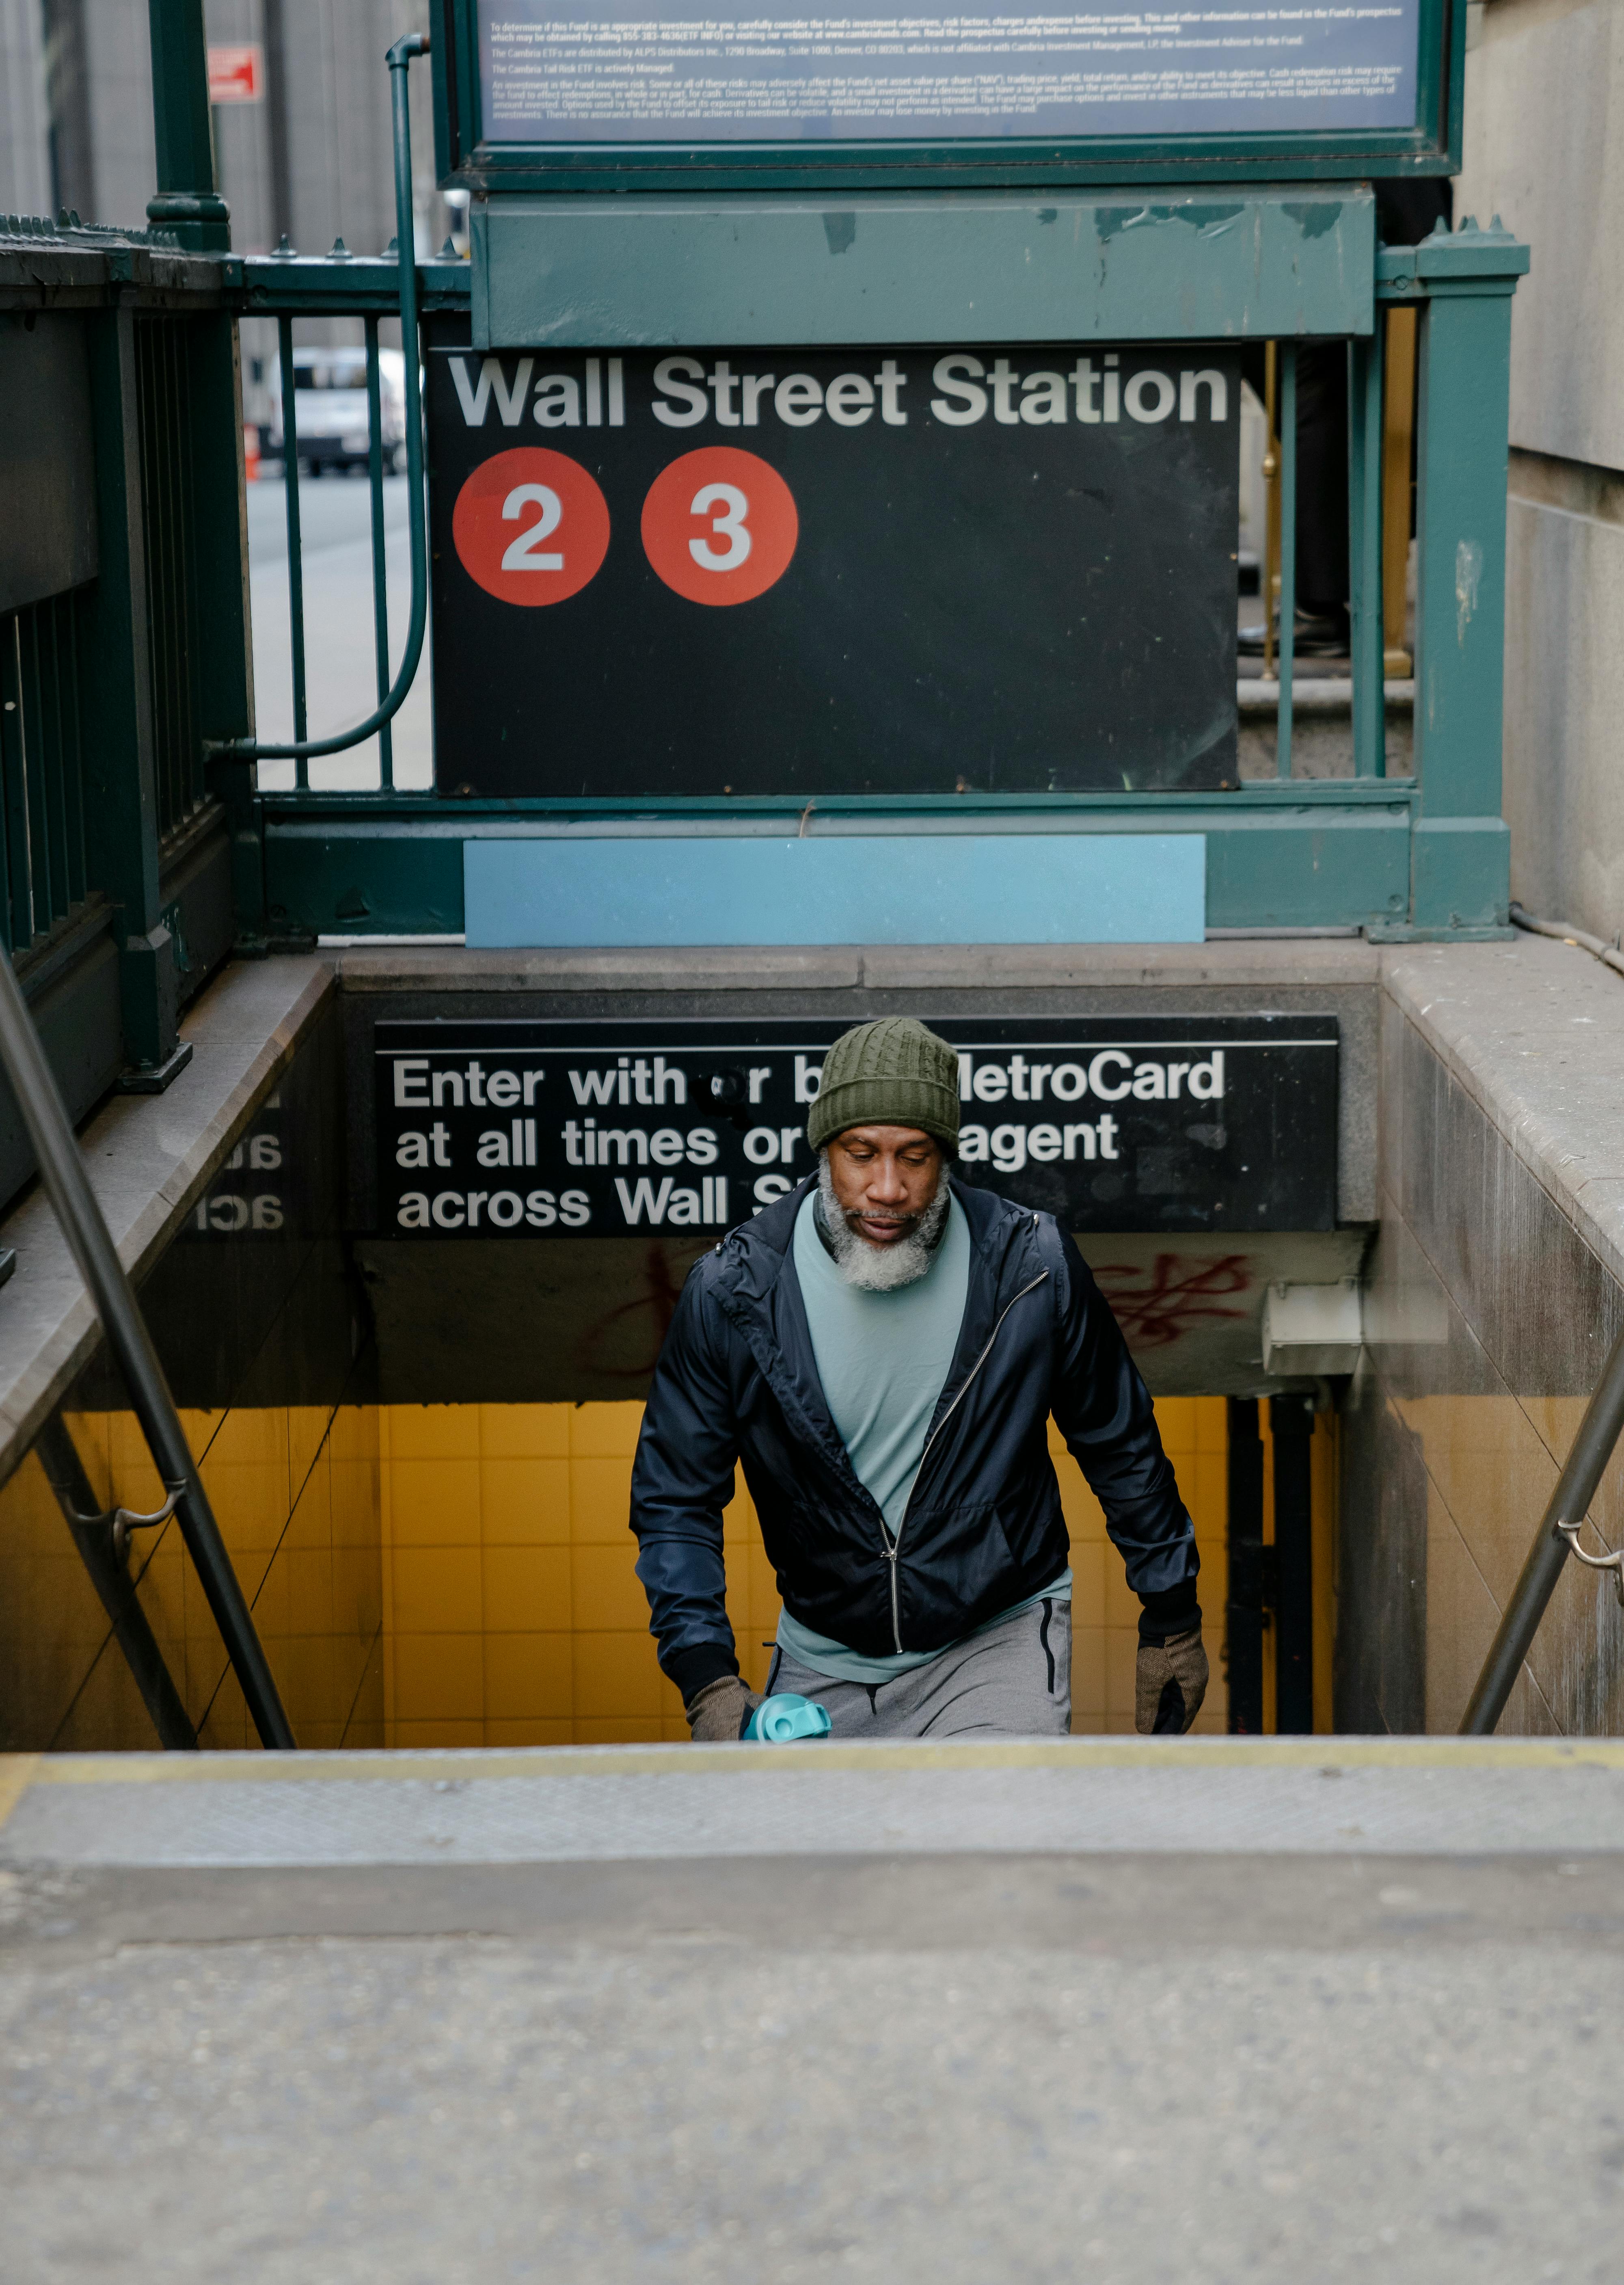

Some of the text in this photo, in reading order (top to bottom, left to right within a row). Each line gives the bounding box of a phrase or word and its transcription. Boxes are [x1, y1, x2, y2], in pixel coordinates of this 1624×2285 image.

[490, 22, 500, 31] To
[501, 22, 542, 31] determine
[543, 22, 550, 31] if
[551, 22, 566, 30] this
[568, 22, 589, 30] Fund
[590, 22, 597, 30] is
[611, 21, 657, 32] appropriate
[658, 20, 703, 30] investment
[704, 20, 716, 29] for
[737, 19, 772, 31] carefully
[773, 19, 807, 28] consider
[809, 19, 823, 28] the
[851, 18, 896, 28] investment
[943, 17, 958, 26] risk
[992, 16, 1024, 28] charges
[1074, 14, 1100, 24] before
[1144, 13, 1160, 22] This
[1162, 13, 1178, 22] and
[1179, 12, 1200, 22] other
[1202, 11, 1249, 21] information
[1267, 10, 1277, 19] be
[1280, 9, 1302, 19] found
[1304, 9, 1312, 18] in
[1313, 9, 1327, 18] the
[1356, 7, 1401, 19] prospectus
[490, 32, 514, 41] which
[515, 34, 532, 43] may
[534, 32, 544, 41] be
[546, 32, 581, 41] obtained
[582, 32, 592, 43] by
[594, 31, 620, 43] calling
[736, 30, 764, 41] visiting
[782, 29, 812, 39] website
[814, 30, 823, 38] at
[923, 27, 944, 37] Read
[945, 27, 958, 36] the
[960, 27, 1004, 39] prospectus
[1006, 26, 1041, 38] carefully
[1043, 25, 1069, 35] before
[1070, 24, 1107, 36] investing
[1119, 23, 1151, 35] sending
[491, 49, 505, 58] The
[507, 48, 540, 58] Cambria
[542, 48, 561, 57] ETFs
[578, 48, 621, 57] distributed
[622, 48, 632, 59] by
[634, 48, 655, 57] ALPS
[657, 47, 704, 56] Distributors
[725, 47, 744, 56] 1290
[789, 46, 808, 55] Suite
[864, 45, 876, 54] CO
[907, 44, 930, 54] which
[931, 44, 939, 53] is
[940, 45, 954, 53] not
[956, 43, 991, 53] affiliated
[992, 43, 1009, 52] with
[1011, 42, 1045, 52] Cambria
[1045, 41, 1090, 51] Investment
[1160, 39, 1173, 49] the
[1175, 38, 1220, 48] Investment
[1221, 37, 1251, 47] Adviser
[1253, 37, 1264, 46] for
[1266, 37, 1279, 46] the
[492, 64, 506, 73] The
[508, 63, 541, 72] Cambria
[544, 63, 557, 72] Tail
[558, 63, 575, 72] Risk
[577, 63, 592, 72] ETF
[594, 63, 601, 72] is
[604, 63, 634, 74] actively
[492, 80, 503, 89] An
[504, 80, 548, 89] investment
[550, 80, 557, 89] in
[559, 80, 572, 89] the
[574, 80, 594, 89] Fund
[596, 80, 628, 89] involves
[649, 79, 671, 88] Some
[684, 79, 693, 88] all
[695, 79, 703, 88] of
[546, 109, 567, 118] There
[569, 109, 576, 118] is
[632, 109, 648, 118] that
[650, 109, 663, 118] the
[664, 108, 685, 118] Fund
[687, 108, 700, 117] will
[702, 108, 732, 117] achieve
[733, 108, 743, 117] its
[745, 108, 789, 117] investment
[831, 107, 842, 116] An
[843, 106, 875, 116] investor
[877, 108, 894, 118] may
[895, 106, 911, 115] lose
[914, 108, 940, 117] money
[941, 105, 951, 117] by
[953, 104, 989, 117] investing
[991, 104, 998, 113] in
[1000, 104, 1013, 113] the
[447, 354, 1228, 428] Wall Street Station
[501, 482, 753, 572] 2 3
[394, 1059, 544, 1107] Enter
[568, 1056, 687, 1105] with
[396, 1113, 1119, 1173] at all times or agent
[397, 1190, 591, 1228] across
[614, 1176, 728, 1225] Wall
